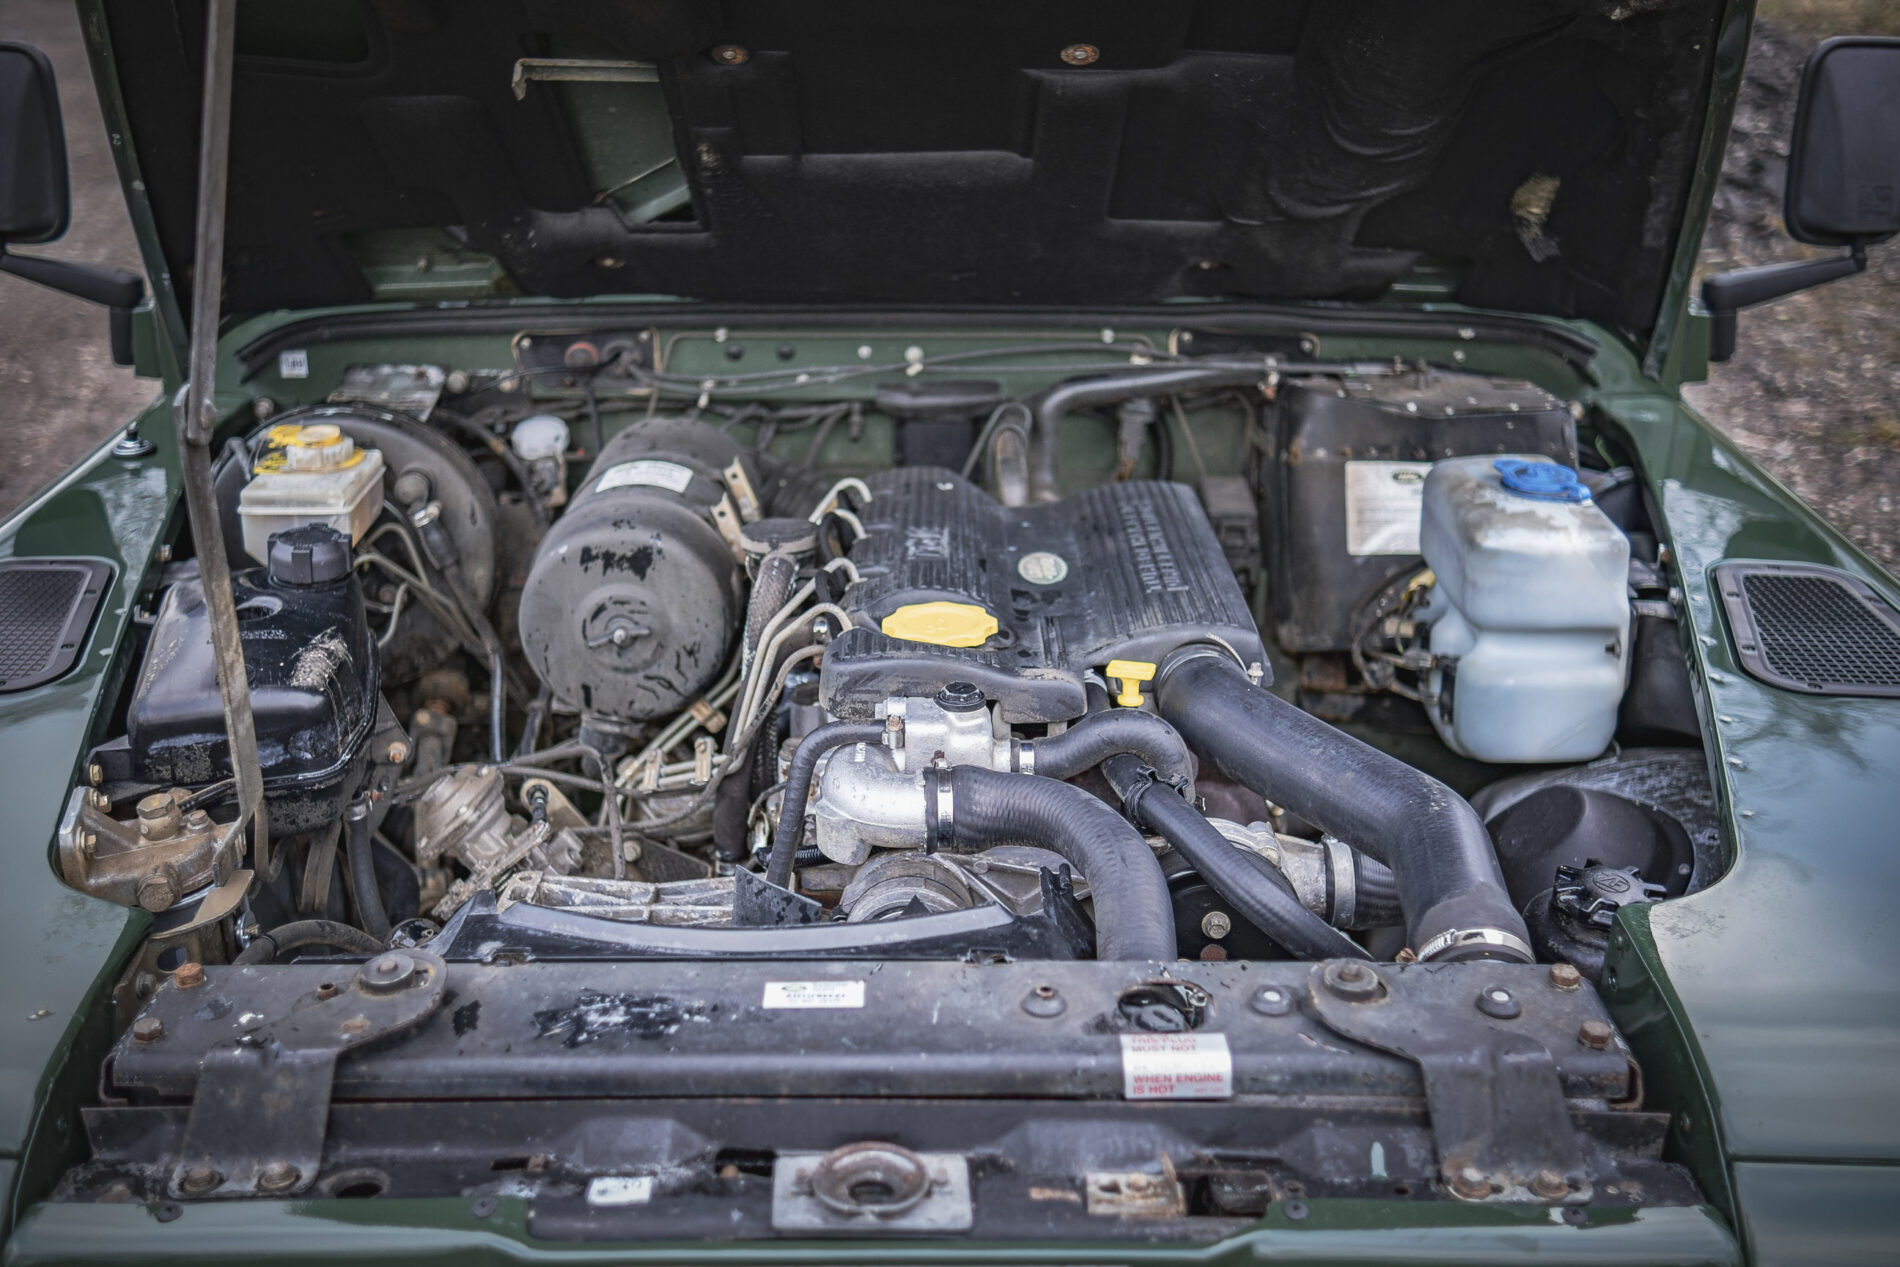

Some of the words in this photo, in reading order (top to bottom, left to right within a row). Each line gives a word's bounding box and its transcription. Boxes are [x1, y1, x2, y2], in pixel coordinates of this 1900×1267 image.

[1131, 1045, 1166, 1053] MUST
[1171, 1045, 1197, 1053] NOT
[1133, 1074, 1172, 1084] WHEN
[1176, 1073, 1223, 1083] ENGINE
[1133, 1085, 1144, 1095] IS
[1148, 1085, 1175, 1094] HOT
